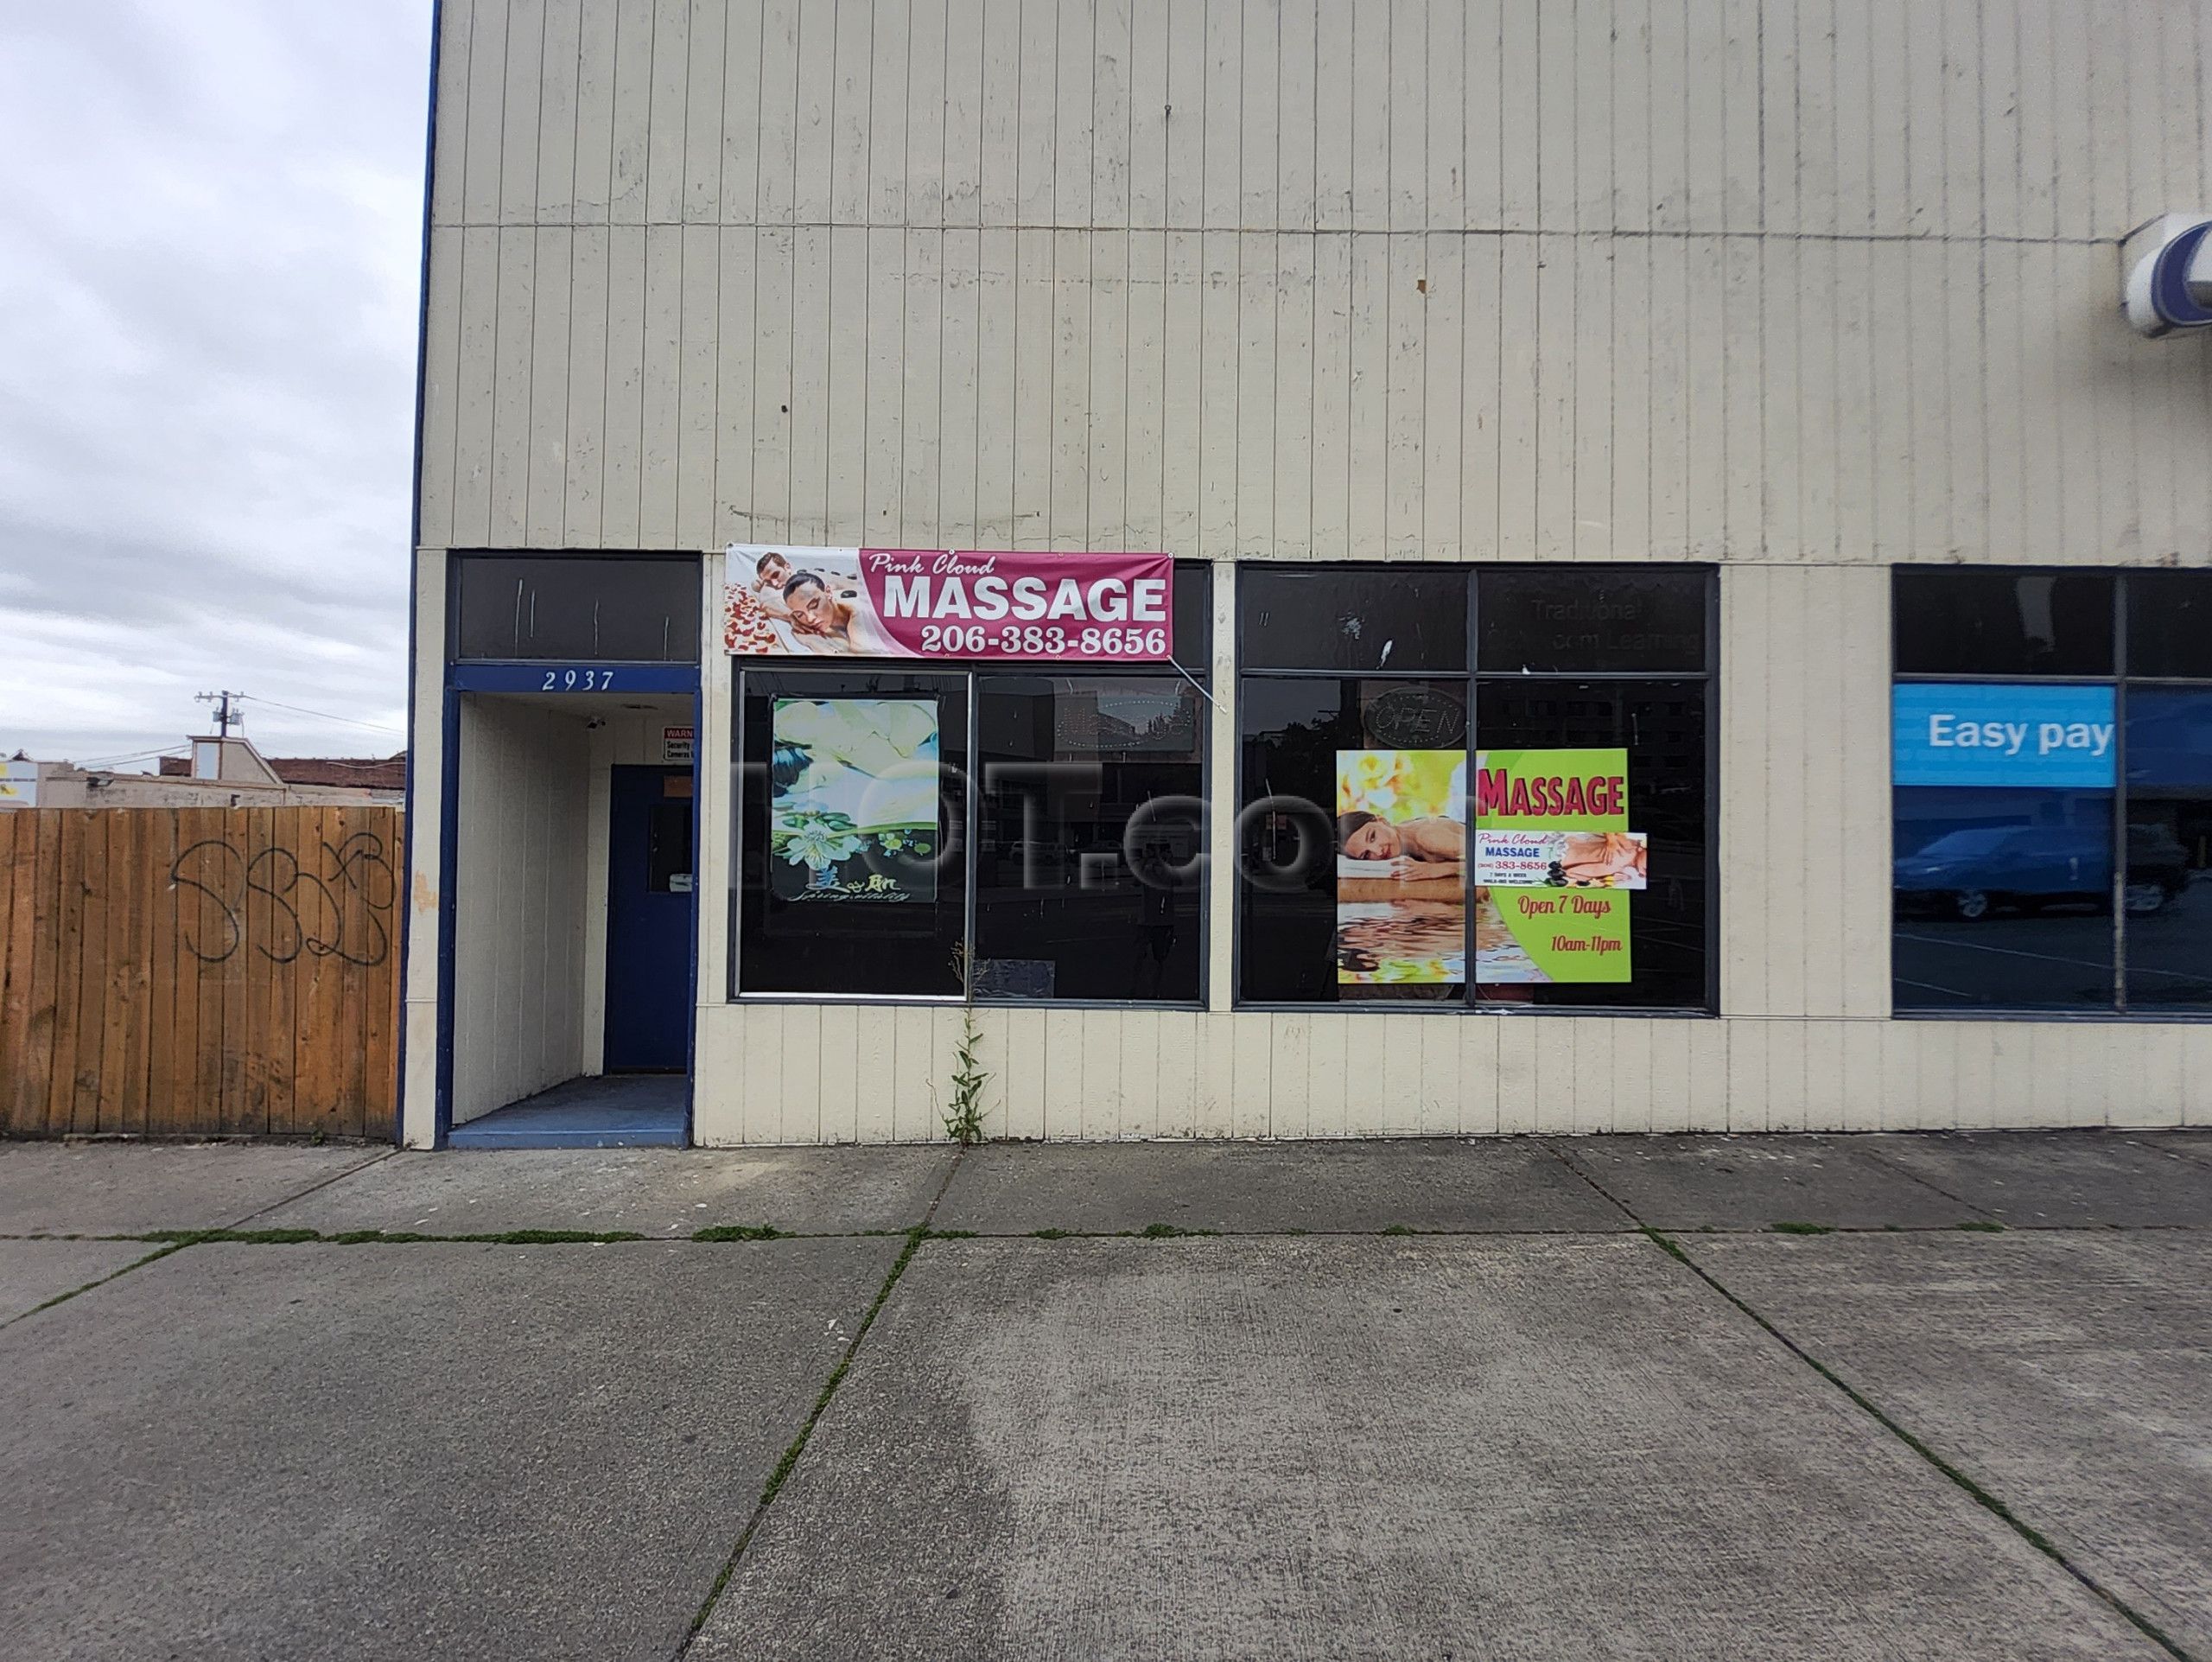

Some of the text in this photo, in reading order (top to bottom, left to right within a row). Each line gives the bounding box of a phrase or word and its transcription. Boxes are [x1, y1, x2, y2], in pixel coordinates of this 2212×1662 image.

[868, 553, 995, 575] Pink Cloud
[882, 576, 1166, 622] MASSAGE
[921, 625, 1166, 654] 206-383-8656
[542, 670, 614, 691] 2937
[1375, 704, 1461, 734] OPEN
[667, 729, 693, 737] WARN
[1929, 714, 2114, 755] Easy pay
[666, 741, 690, 750] Security
[1477, 831, 1549, 844] Pink Cloud
[1484, 847, 1541, 857] MASSAGE
[1495, 861, 1548, 871] 383-8656
[1518, 895, 1611, 919] Open 7 Days
[1551, 936, 1623, 956] 10am-11pm
